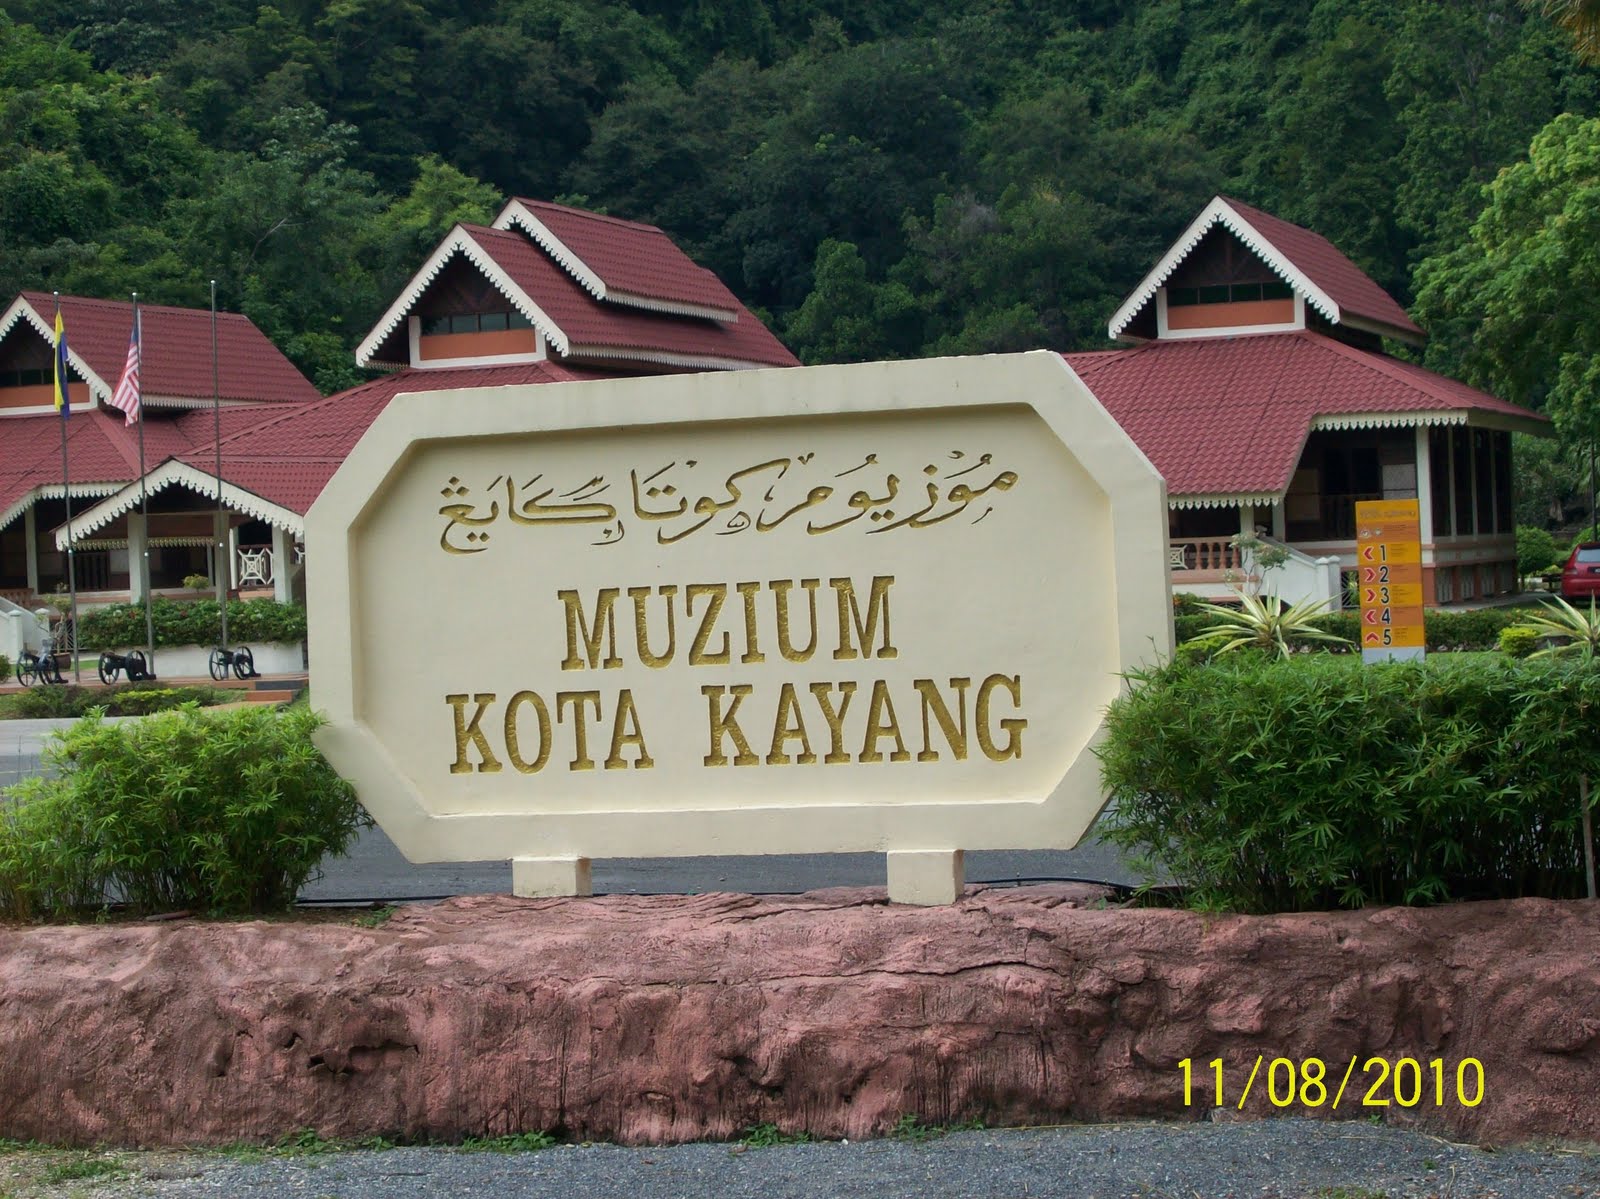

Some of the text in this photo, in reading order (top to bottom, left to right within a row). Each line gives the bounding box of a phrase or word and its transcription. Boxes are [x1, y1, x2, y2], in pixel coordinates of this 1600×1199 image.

[1379, 544, 1387, 562] 1
[1379, 565, 1389, 583] 2
[1380, 586, 1390, 604] 3
[557, 575, 899, 671] MUZIUM
[1381, 607, 1391, 625] 4
[1383, 628, 1392, 646] 5
[445, 673, 1028, 774] KOTA KAYANG
